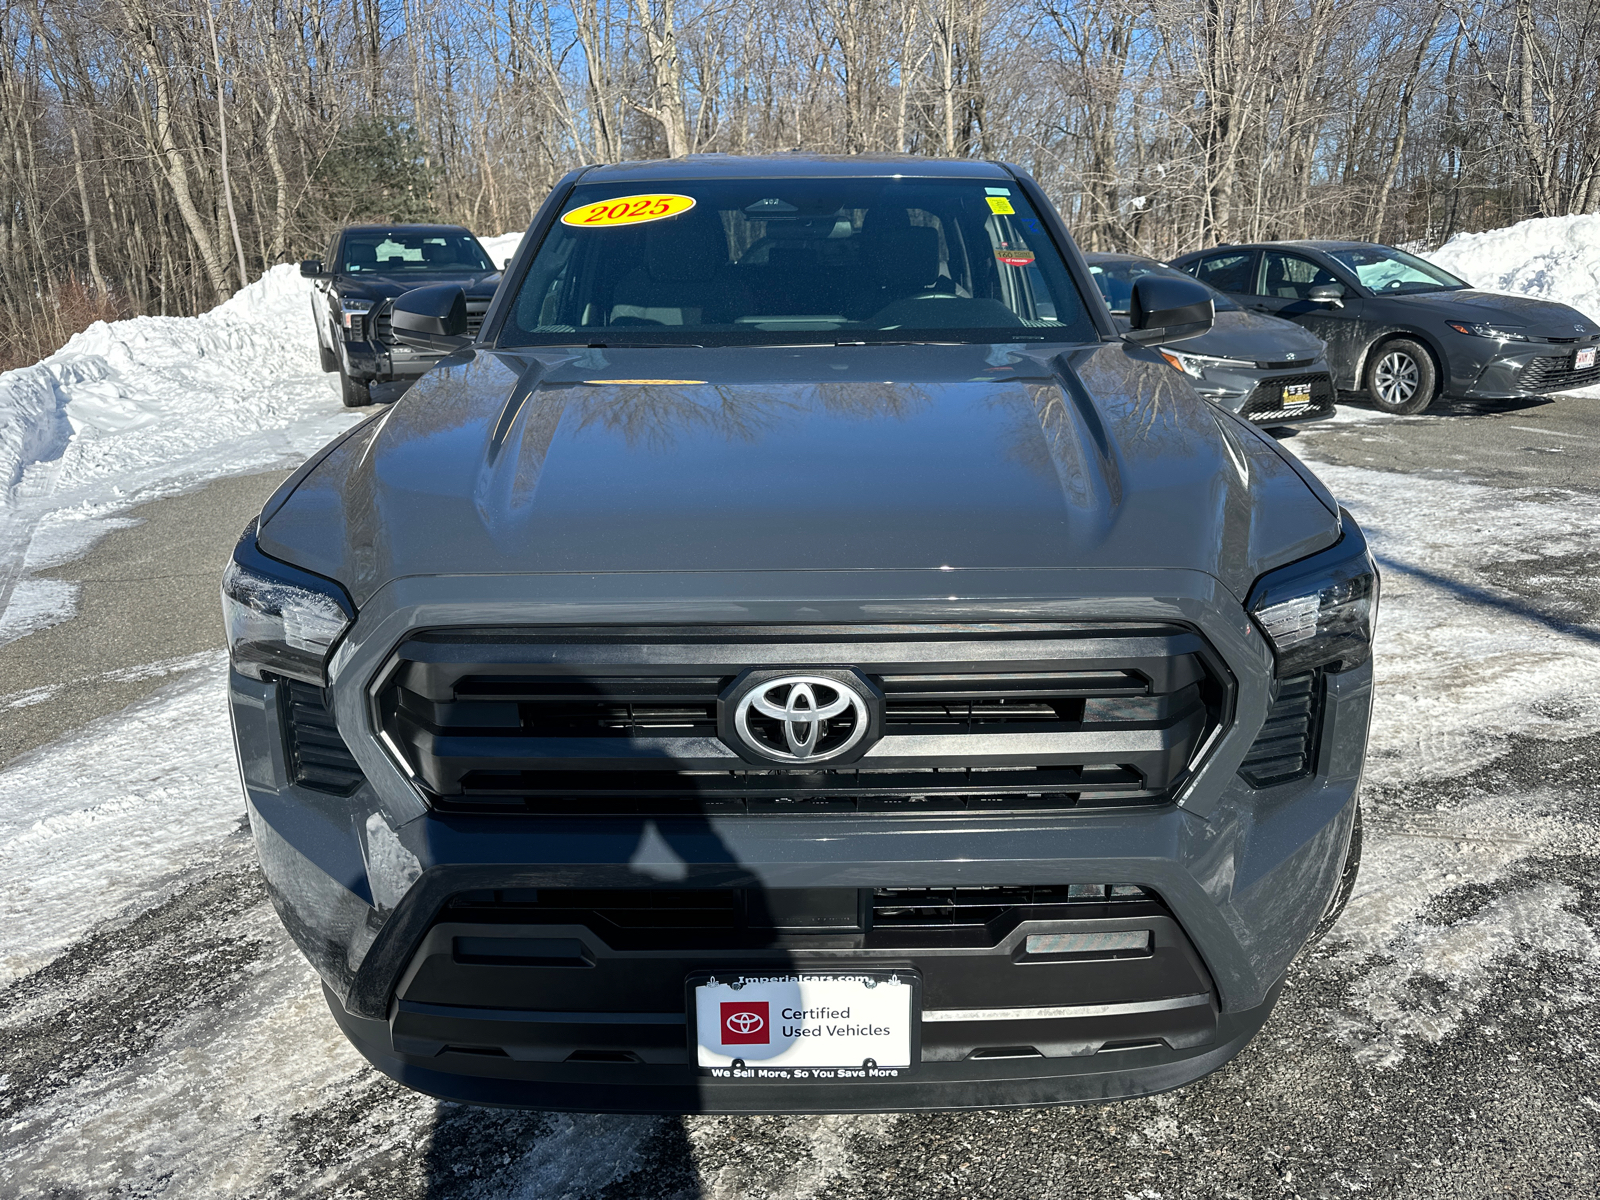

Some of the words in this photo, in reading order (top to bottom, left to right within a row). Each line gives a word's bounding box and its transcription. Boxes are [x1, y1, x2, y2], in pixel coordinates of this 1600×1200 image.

[584, 198, 673, 222] 2025
[738, 975, 869, 984] Imperialcars.com
[781, 1007, 851, 1020] Certified
[782, 1025, 822, 1037] Used
[827, 1025, 891, 1037] Vehicles
[711, 1069, 730, 1078] We
[733, 1069, 755, 1078] Sell
[758, 1069, 791, 1079] More,
[794, 1069, 809, 1078] So
[813, 1069, 835, 1078] You
[838, 1069, 866, 1078] Save
[869, 1068, 898, 1077] More
